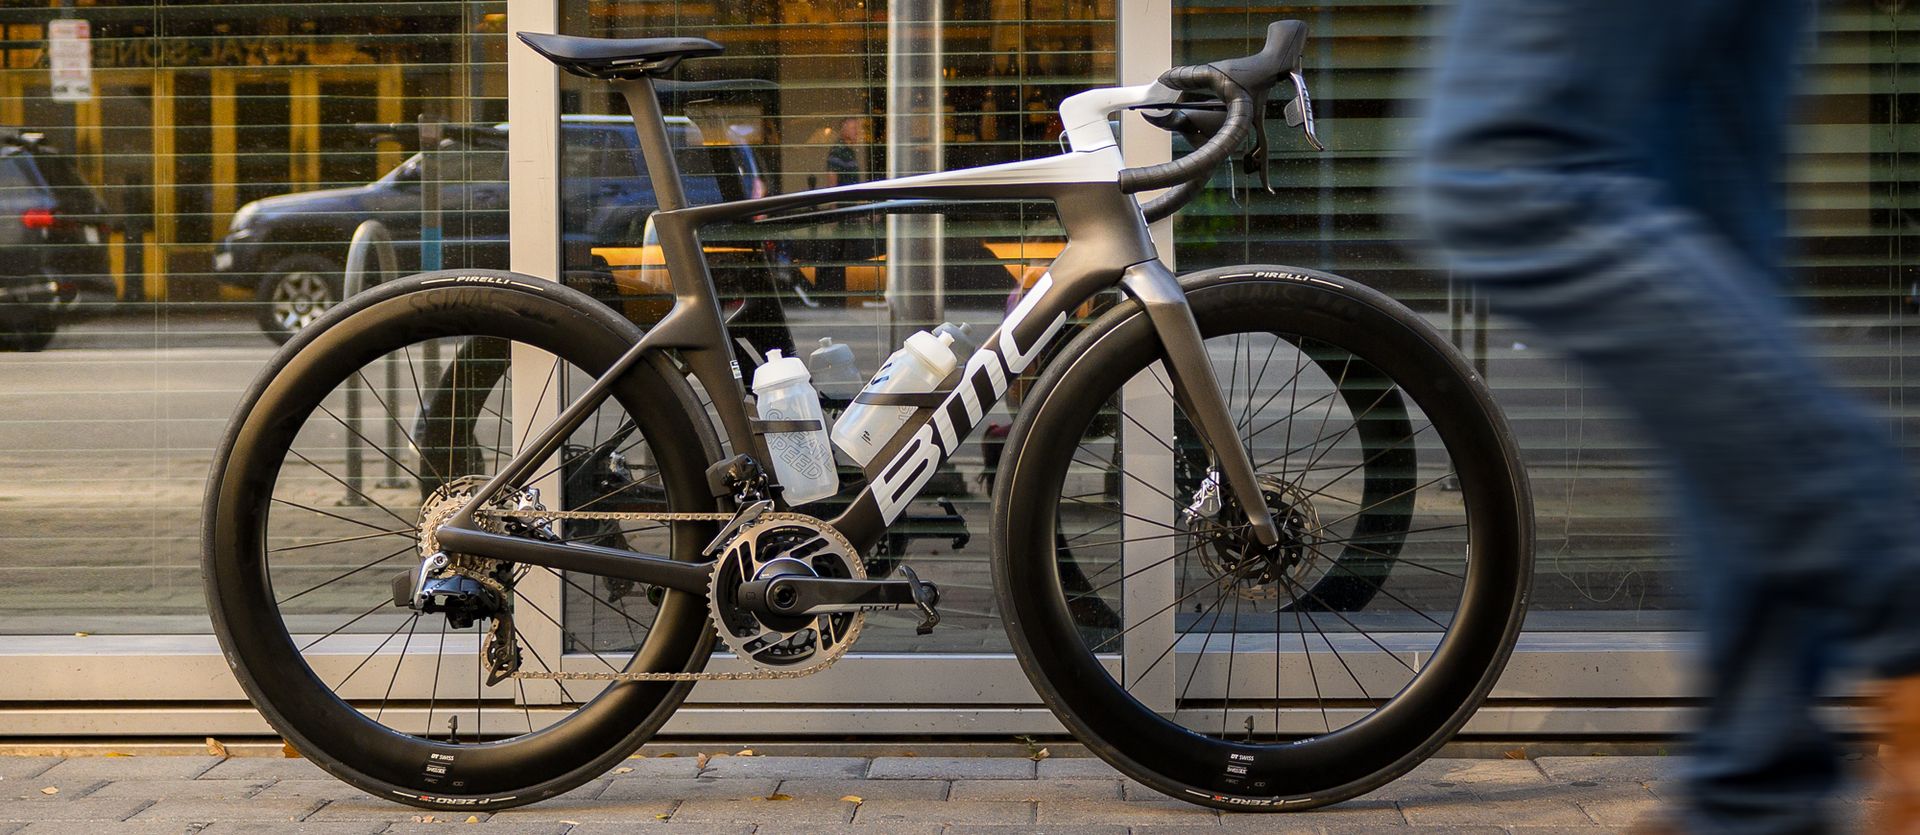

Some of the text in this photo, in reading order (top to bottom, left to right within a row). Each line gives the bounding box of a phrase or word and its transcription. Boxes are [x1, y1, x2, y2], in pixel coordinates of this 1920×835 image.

[456, 276, 509, 285] PIRELLI
[1255, 271, 1308, 281] PIRELLI
[870, 271, 1067, 527] BMC
[436, 797, 478, 805] ZERO
[1229, 798, 1272, 806] ZERO
